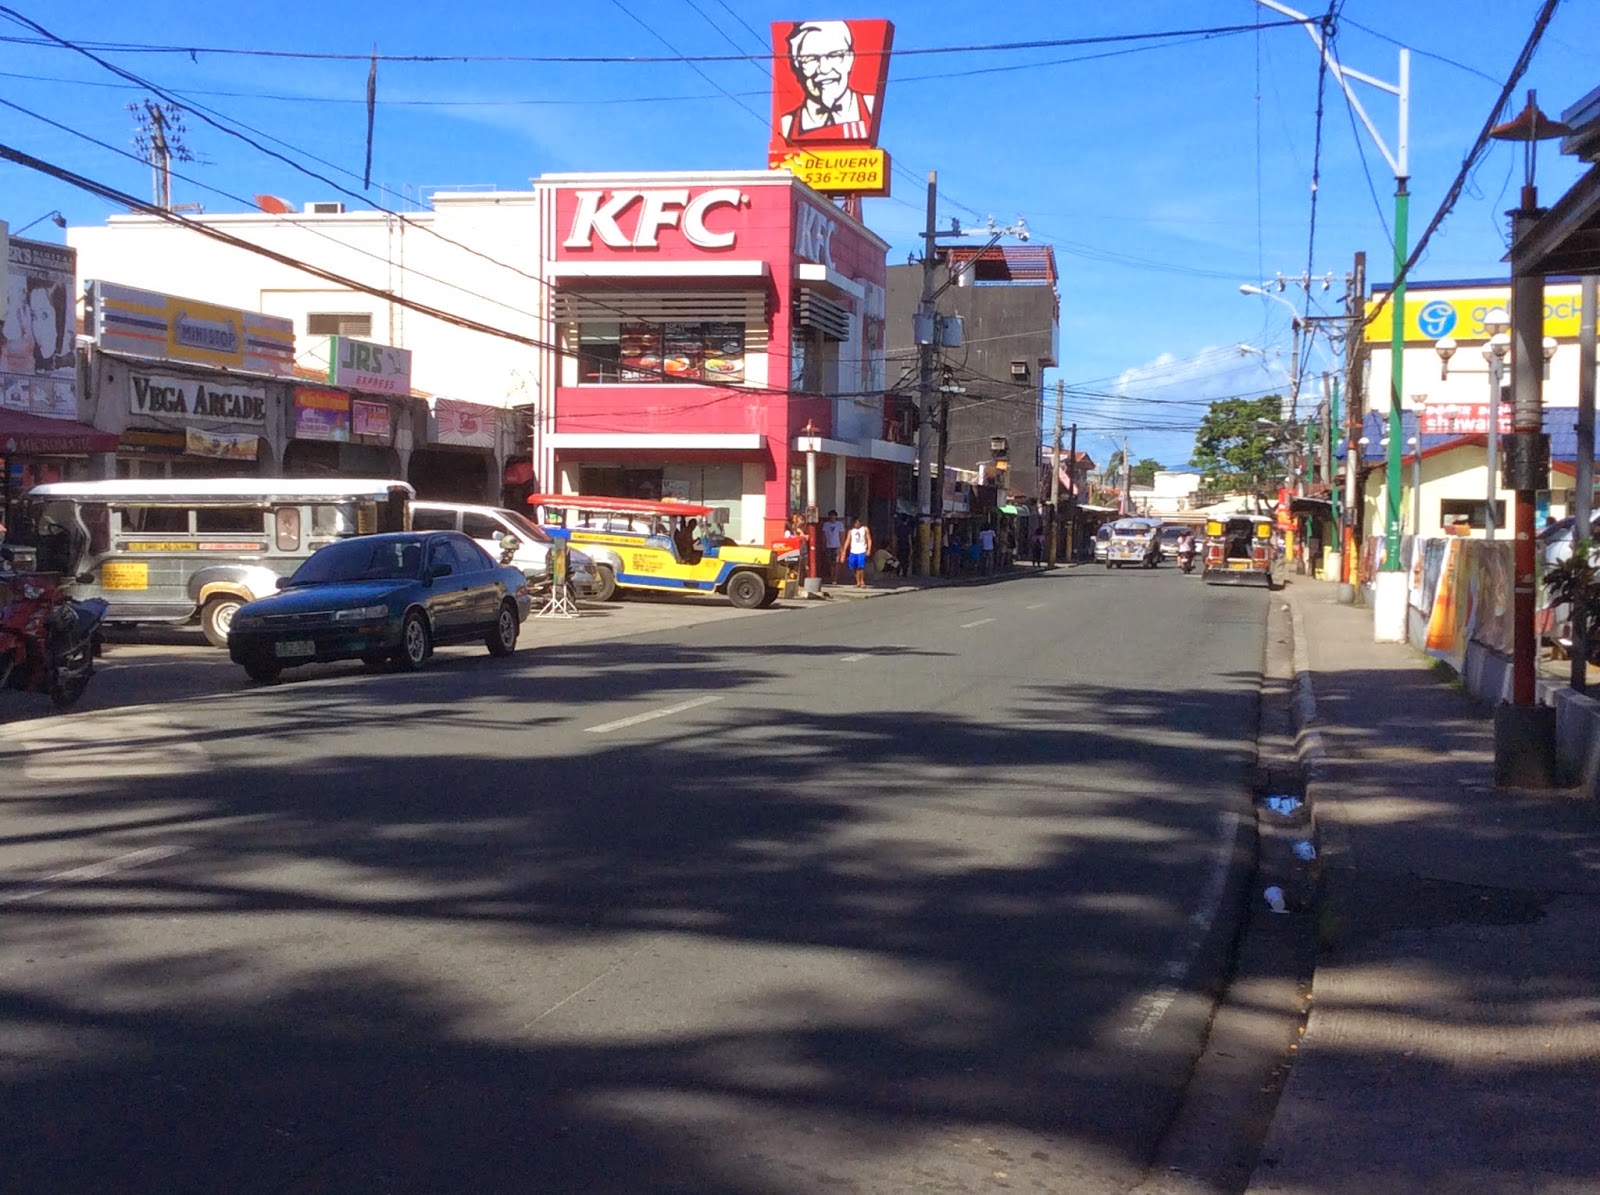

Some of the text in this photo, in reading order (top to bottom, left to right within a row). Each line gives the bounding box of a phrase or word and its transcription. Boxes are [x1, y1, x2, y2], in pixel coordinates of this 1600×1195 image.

[805, 157, 878, 170] DELIVERY
[805, 171, 878, 184] 536-7788
[563, 188, 741, 250] KFC
[794, 201, 837, 271] KFC
[181, 322, 236, 347] MINISTOP
[342, 342, 383, 373] JRS
[356, 375, 396, 390] EXPRESS
